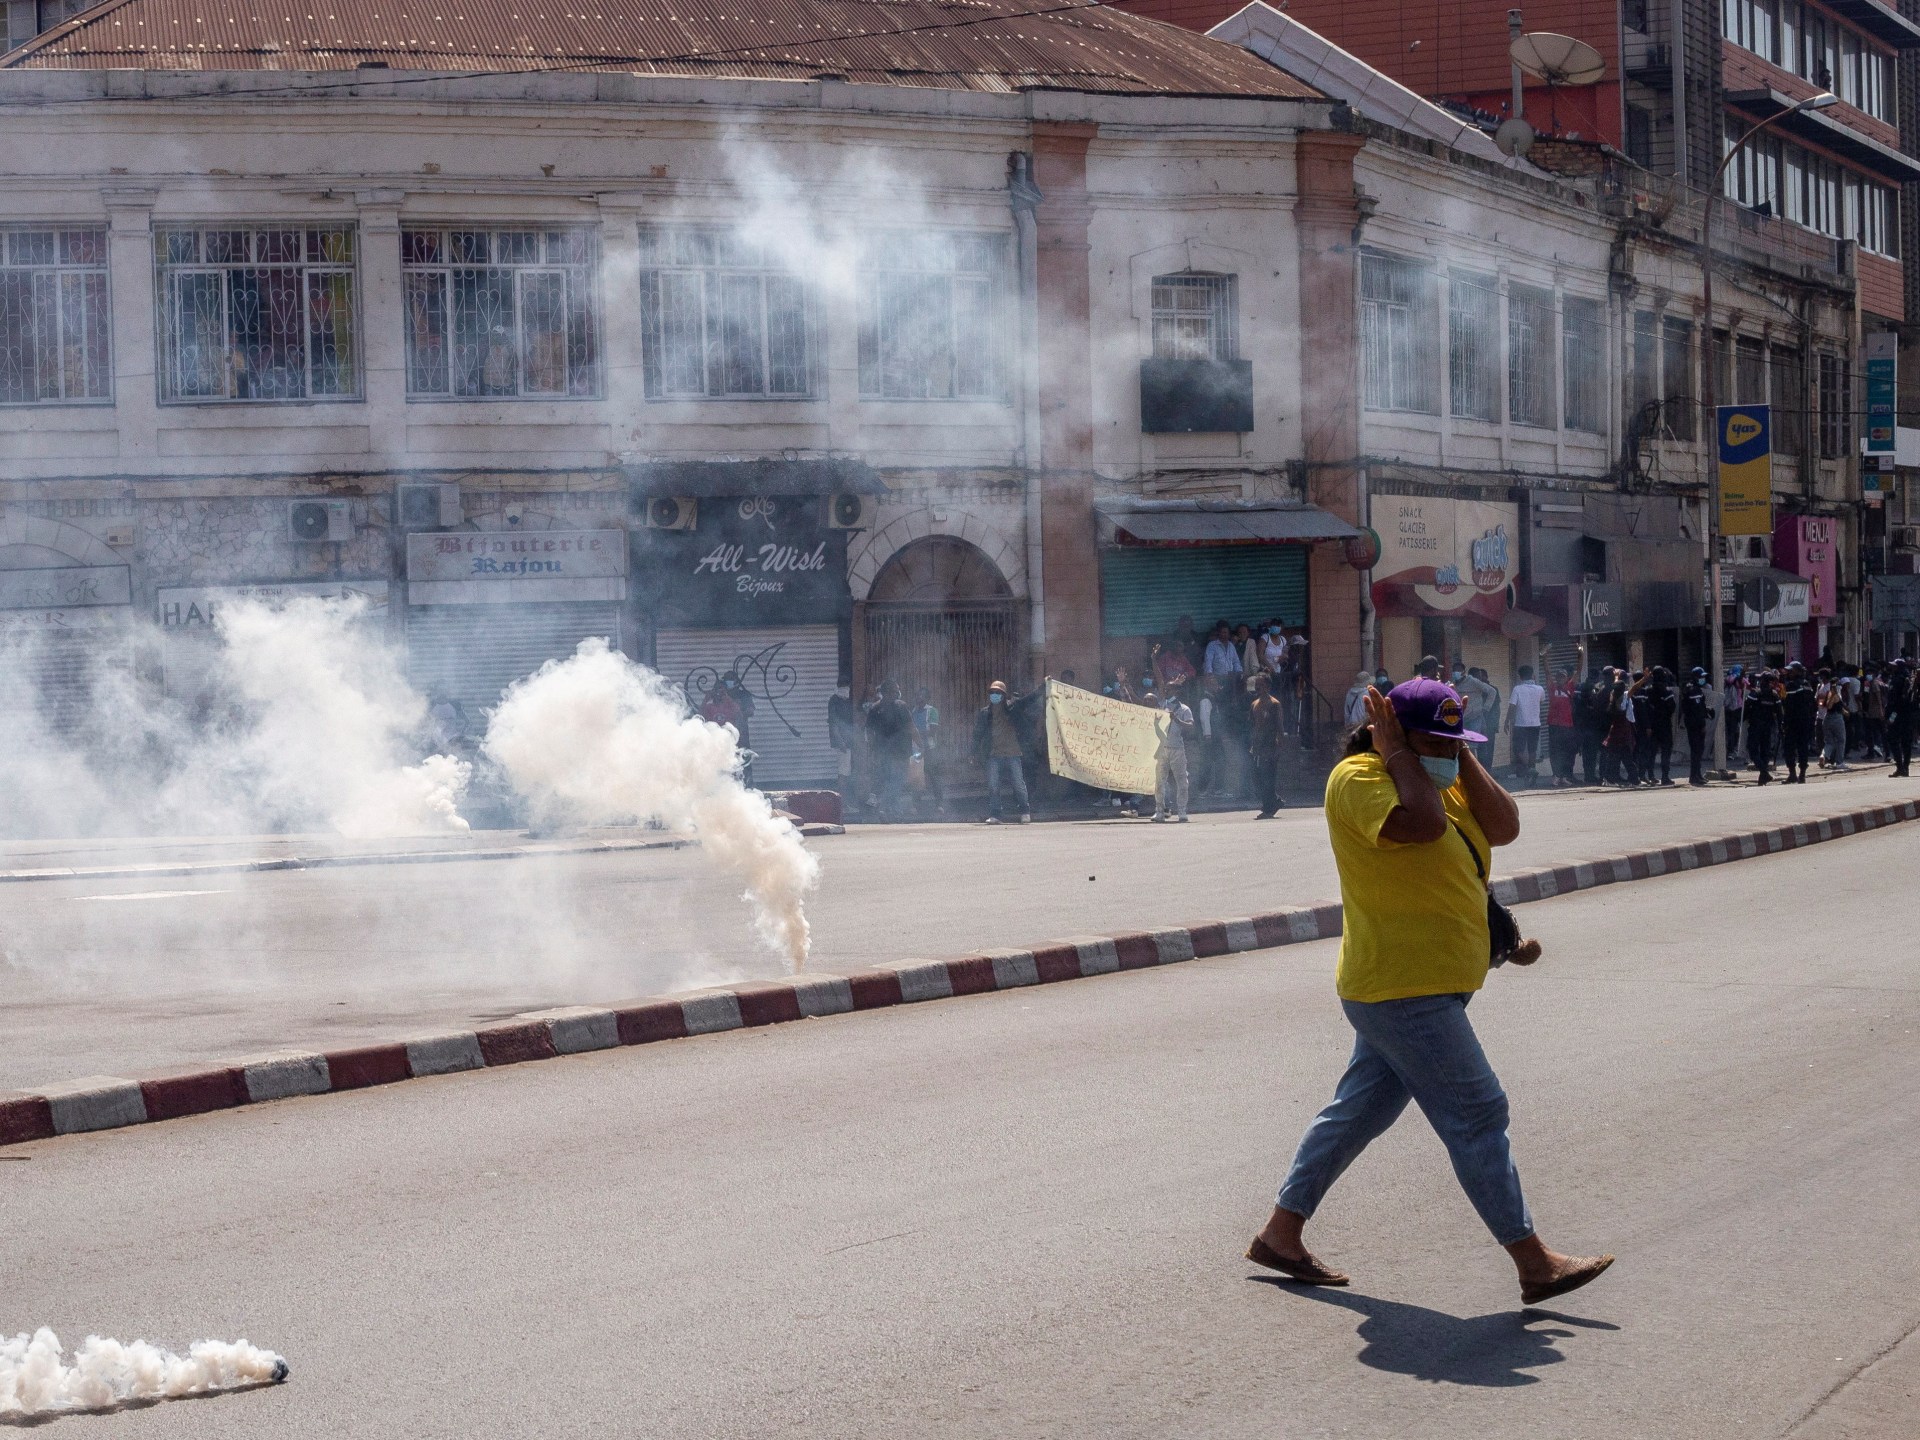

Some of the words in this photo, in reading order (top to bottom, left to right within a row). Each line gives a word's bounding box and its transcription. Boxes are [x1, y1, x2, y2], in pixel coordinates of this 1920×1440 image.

[1398, 507, 1422, 518] SNACK
[1398, 521, 1426, 534] GLACIER
[1804, 521, 1831, 543] MENJA
[435, 537, 602, 556] Bijouterie
[1398, 536, 1438, 550] PATISSERIE
[471, 557, 563, 575] Rajou
[736, 574, 784, 598] Bijoux
[1583, 589, 1609, 630] KALIDAS
[1060, 716, 1089, 732] SANS
[1094, 725, 1118, 740] EAU
